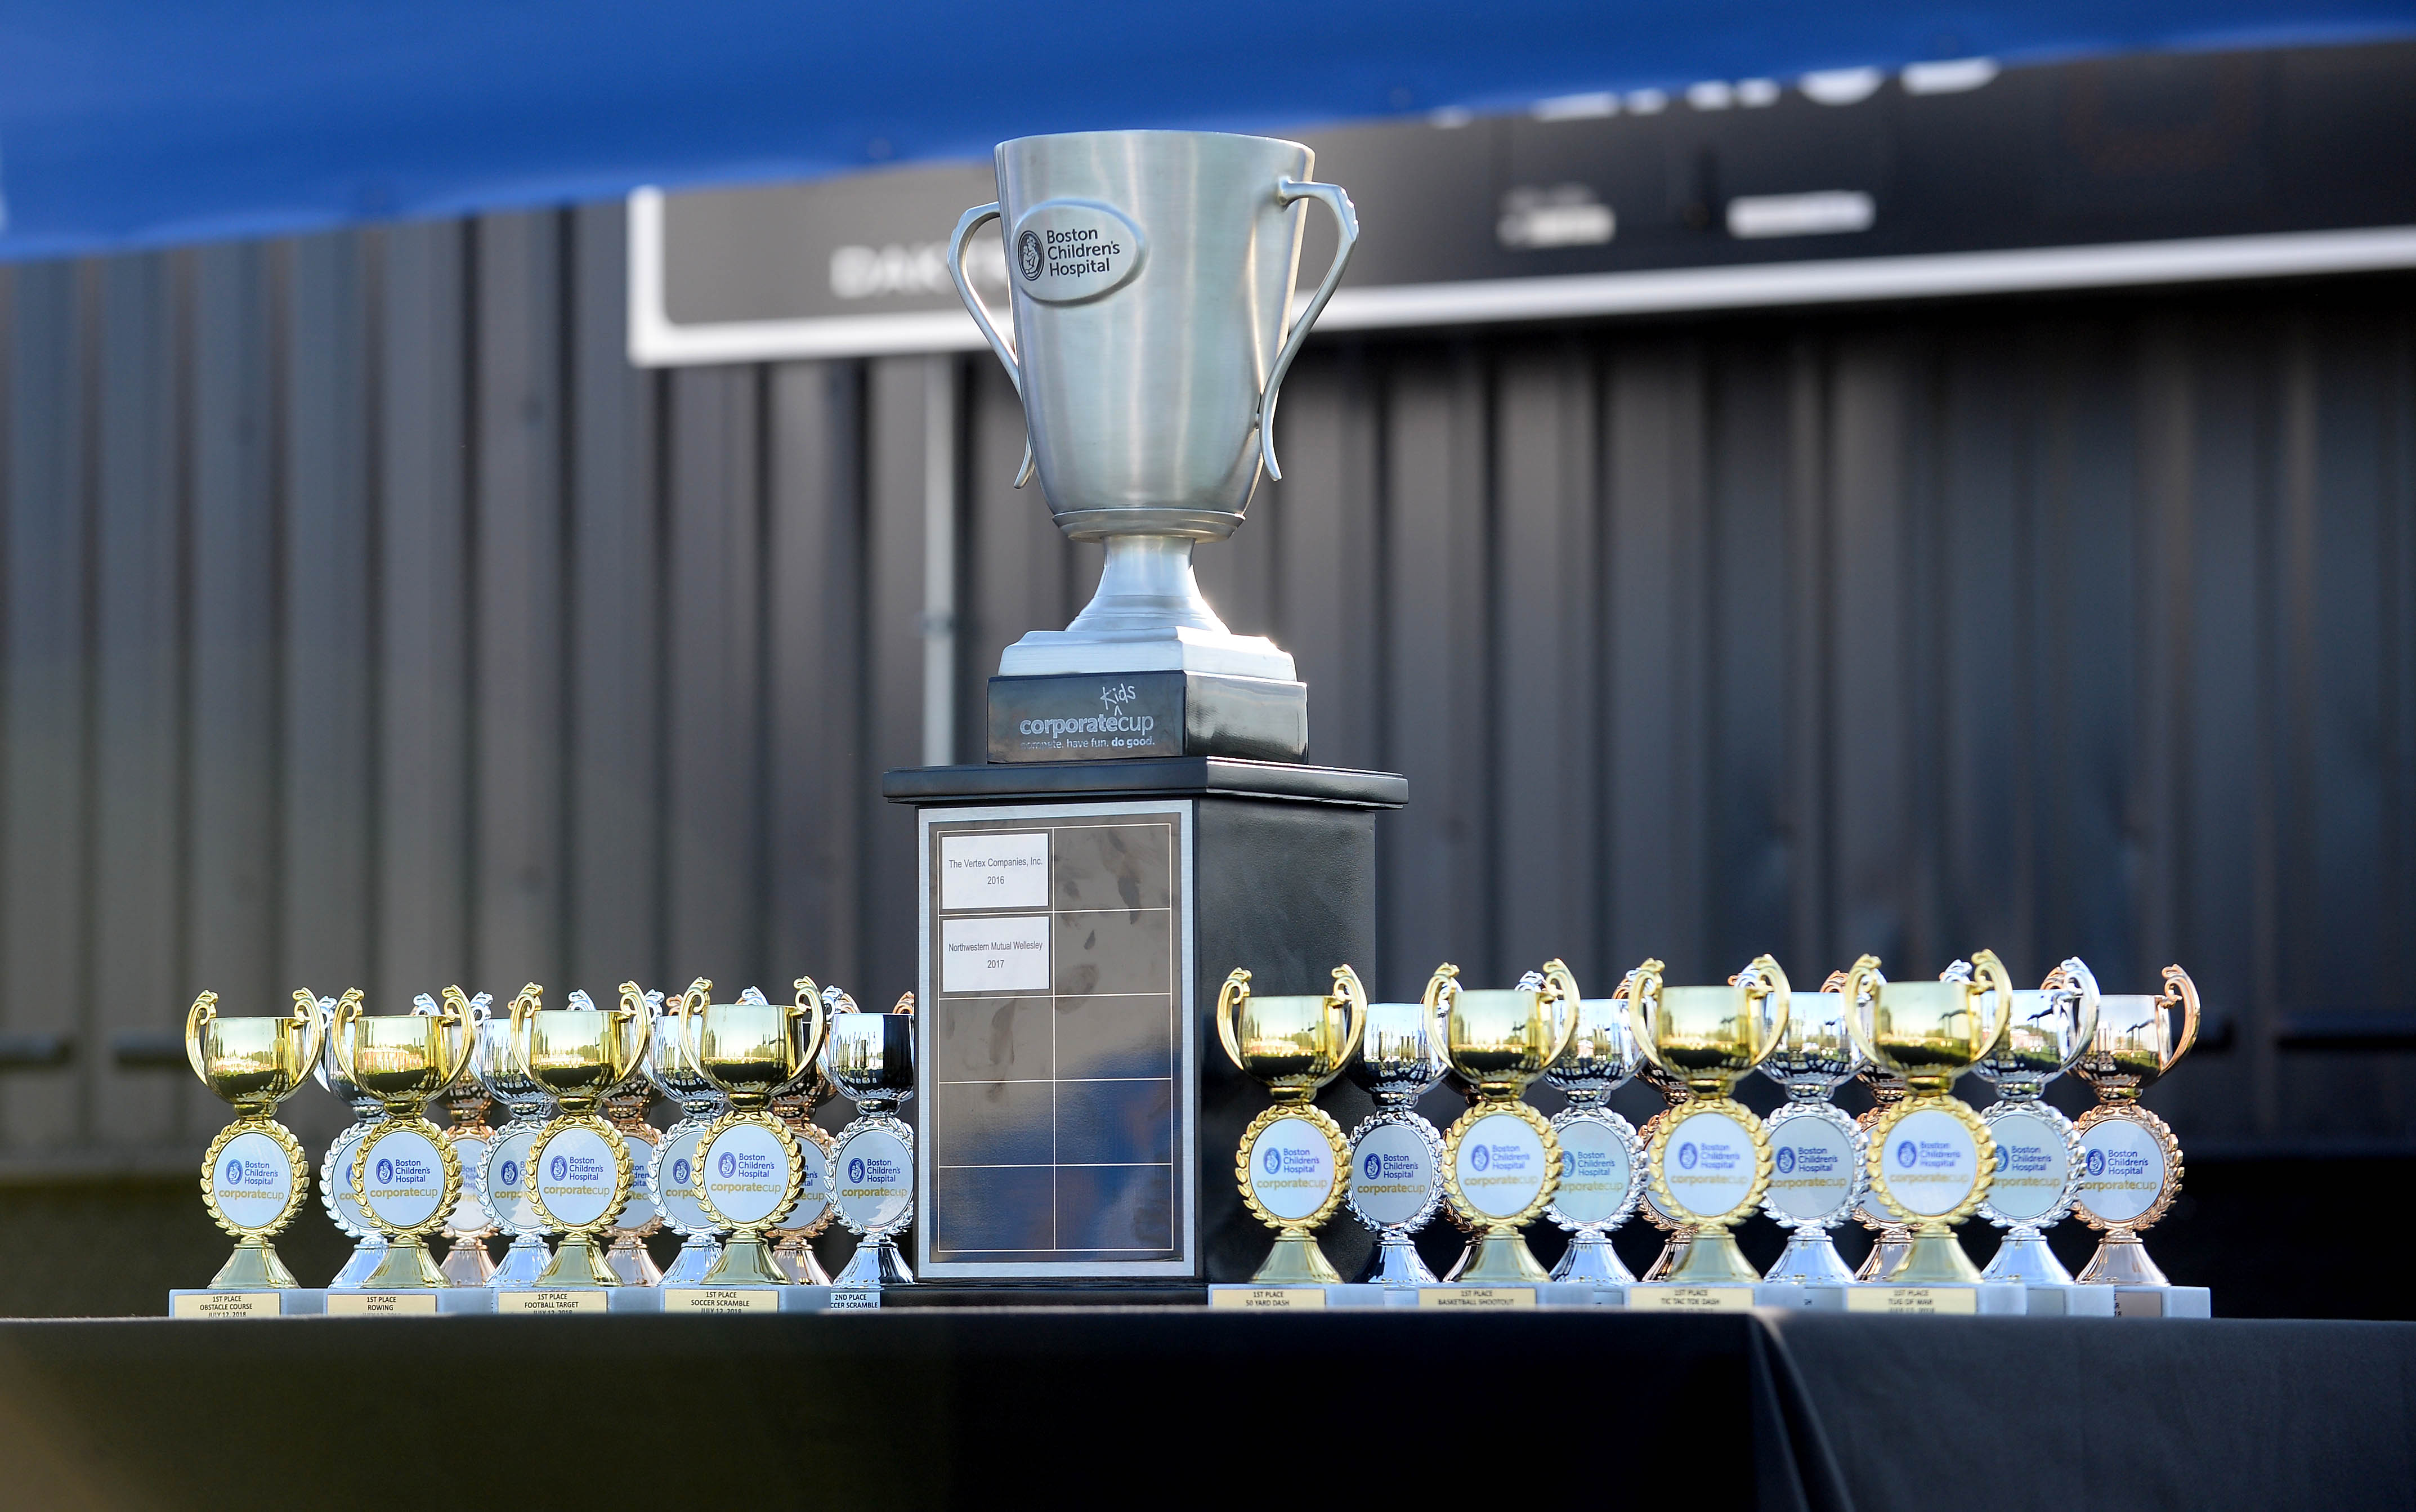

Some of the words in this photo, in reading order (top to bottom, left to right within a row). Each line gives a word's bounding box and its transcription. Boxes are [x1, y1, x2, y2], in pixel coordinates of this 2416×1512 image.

[1046, 229, 1098, 244] Boston
[1048, 241, 1120, 260] Children's
[1049, 258, 1110, 278] Hospital
[1019, 714, 1153, 739] corporatecup
[1067, 739, 1089, 748] have
[1091, 738, 1109, 748] fun.
[1111, 737, 1125, 746] do
[1126, 736, 1155, 748] good.
[948, 860, 962, 868] The
[964, 859, 986, 867] Vertex
[987, 857, 1028, 869] Companies,
[1031, 857, 1043, 865] Inc.
[987, 876, 1005, 884] 2016
[948, 943, 989, 952] Northwestern
[991, 942, 1012, 950] Mutual
[1013, 941, 1043, 951] Wellesley
[987, 960, 1005, 968] 2017
[1283, 1165, 1315, 1175] Hospital
[1578, 1168, 1610, 1177] Hospital
[1798, 1164, 1833, 1173] Hospital
[2108, 1167, 2143, 1177] Hospital
[396, 1175, 426, 1183] Hospital
[570, 1173, 599, 1182] Hospital
[739, 1170, 769, 1179] Hospital
[867, 1175, 896, 1183] Hospital
[1384, 1171, 1413, 1179] Hospital
[244, 1177, 273, 1186] Hospital
[370, 1187, 438, 1199] corporatecup
[544, 1186, 610, 1197] corporatecup
[710, 1183, 781, 1194] corporatecup
[842, 1188, 907, 1198] corporatecup
[1357, 1183, 1425, 1195] corporatecup
[218, 1189, 284, 1202] corporatecup
